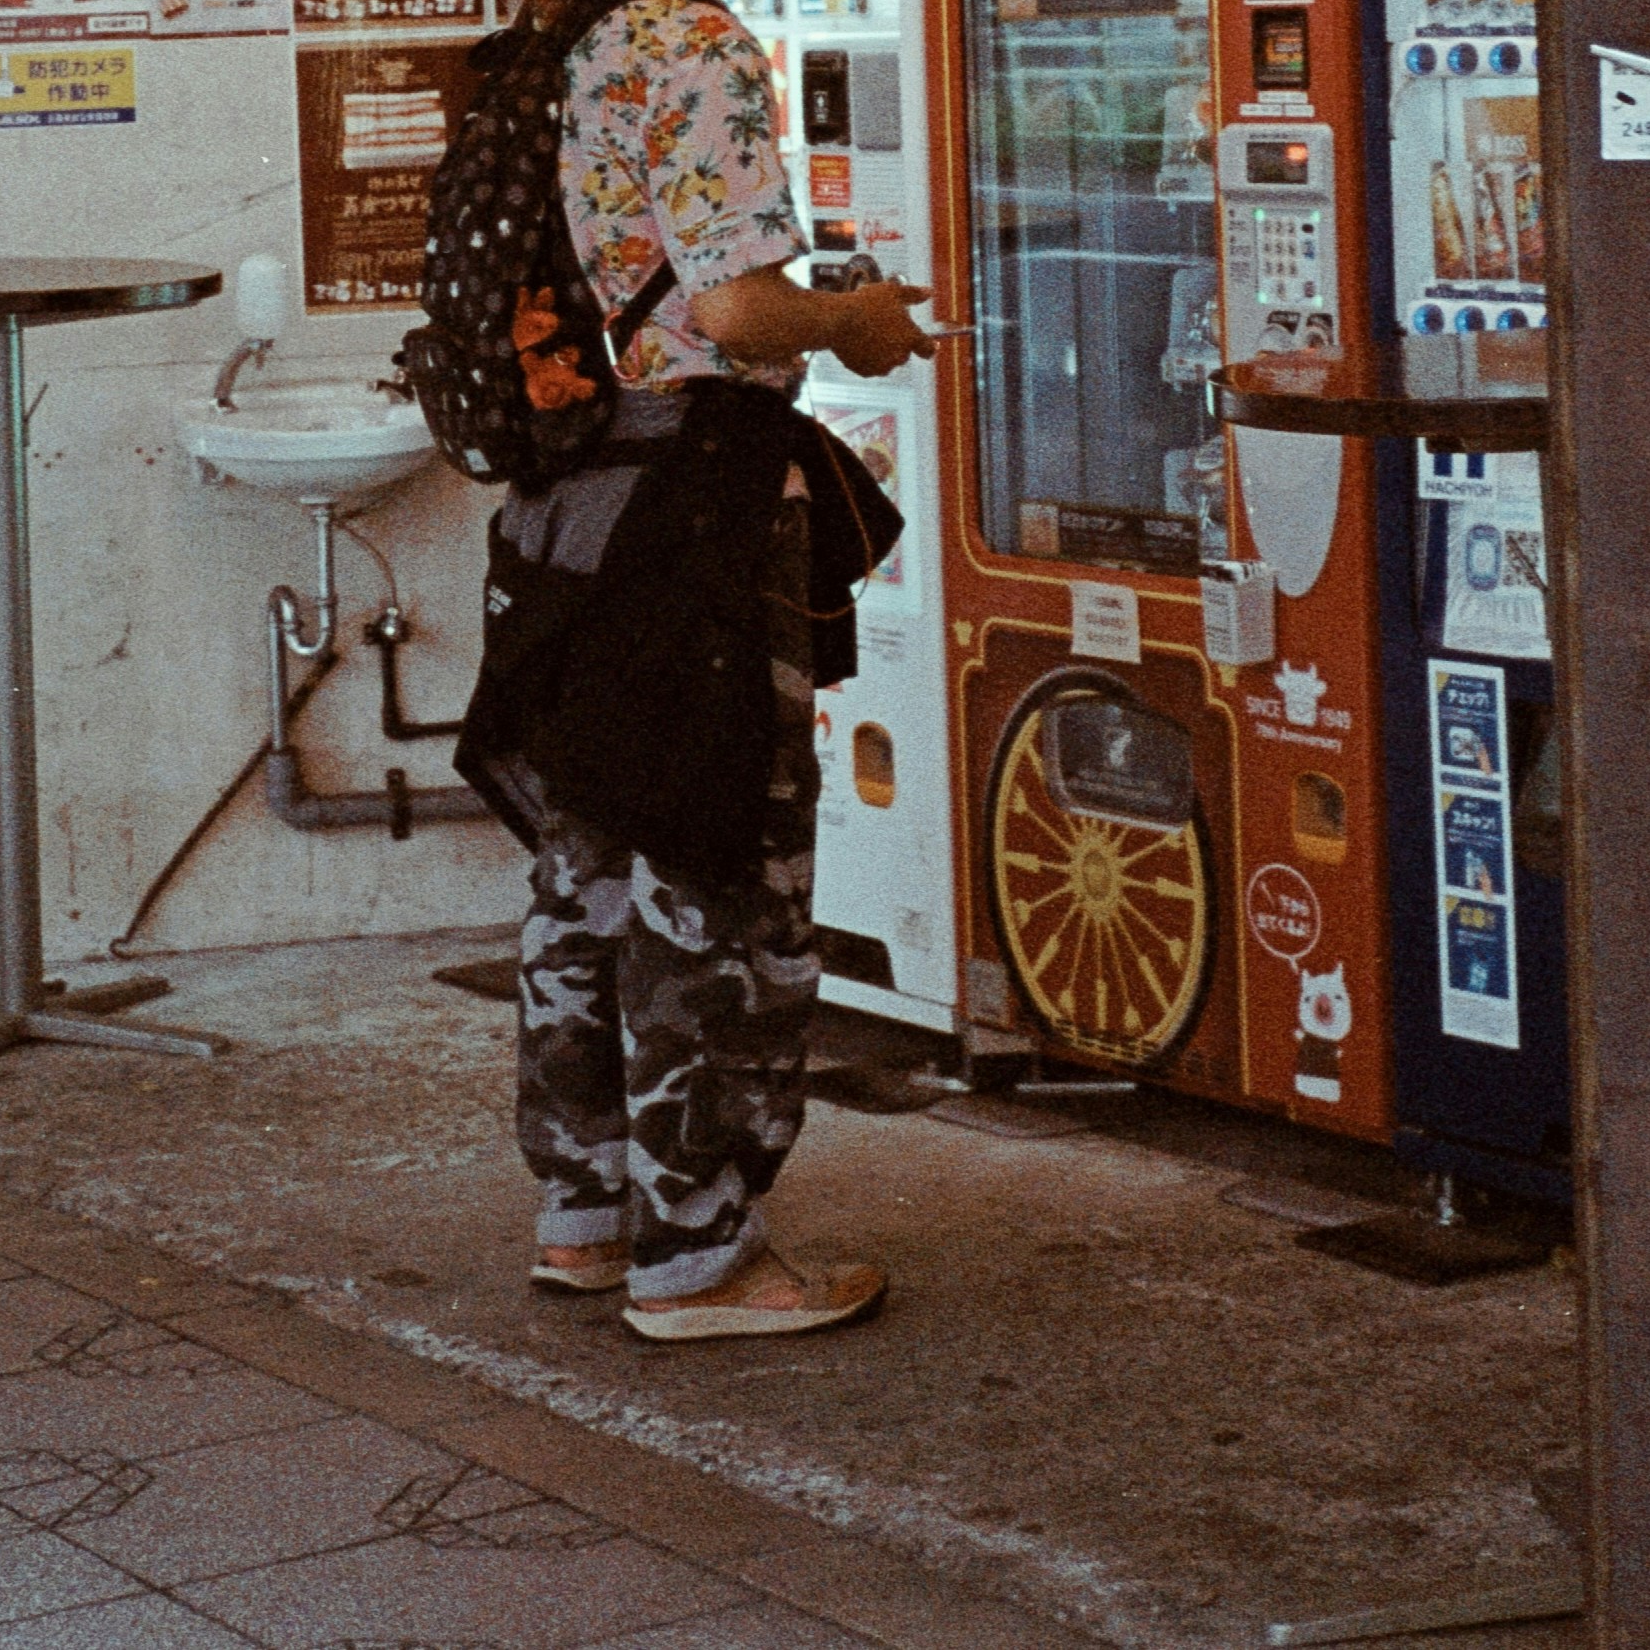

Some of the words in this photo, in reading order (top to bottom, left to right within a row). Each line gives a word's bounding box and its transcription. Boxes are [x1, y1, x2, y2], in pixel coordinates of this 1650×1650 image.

[28, 56, 127, 79] 防犯カメラ
[48, 82, 110, 102] 作動中
[1246, 695, 1281, 720] SINCE
